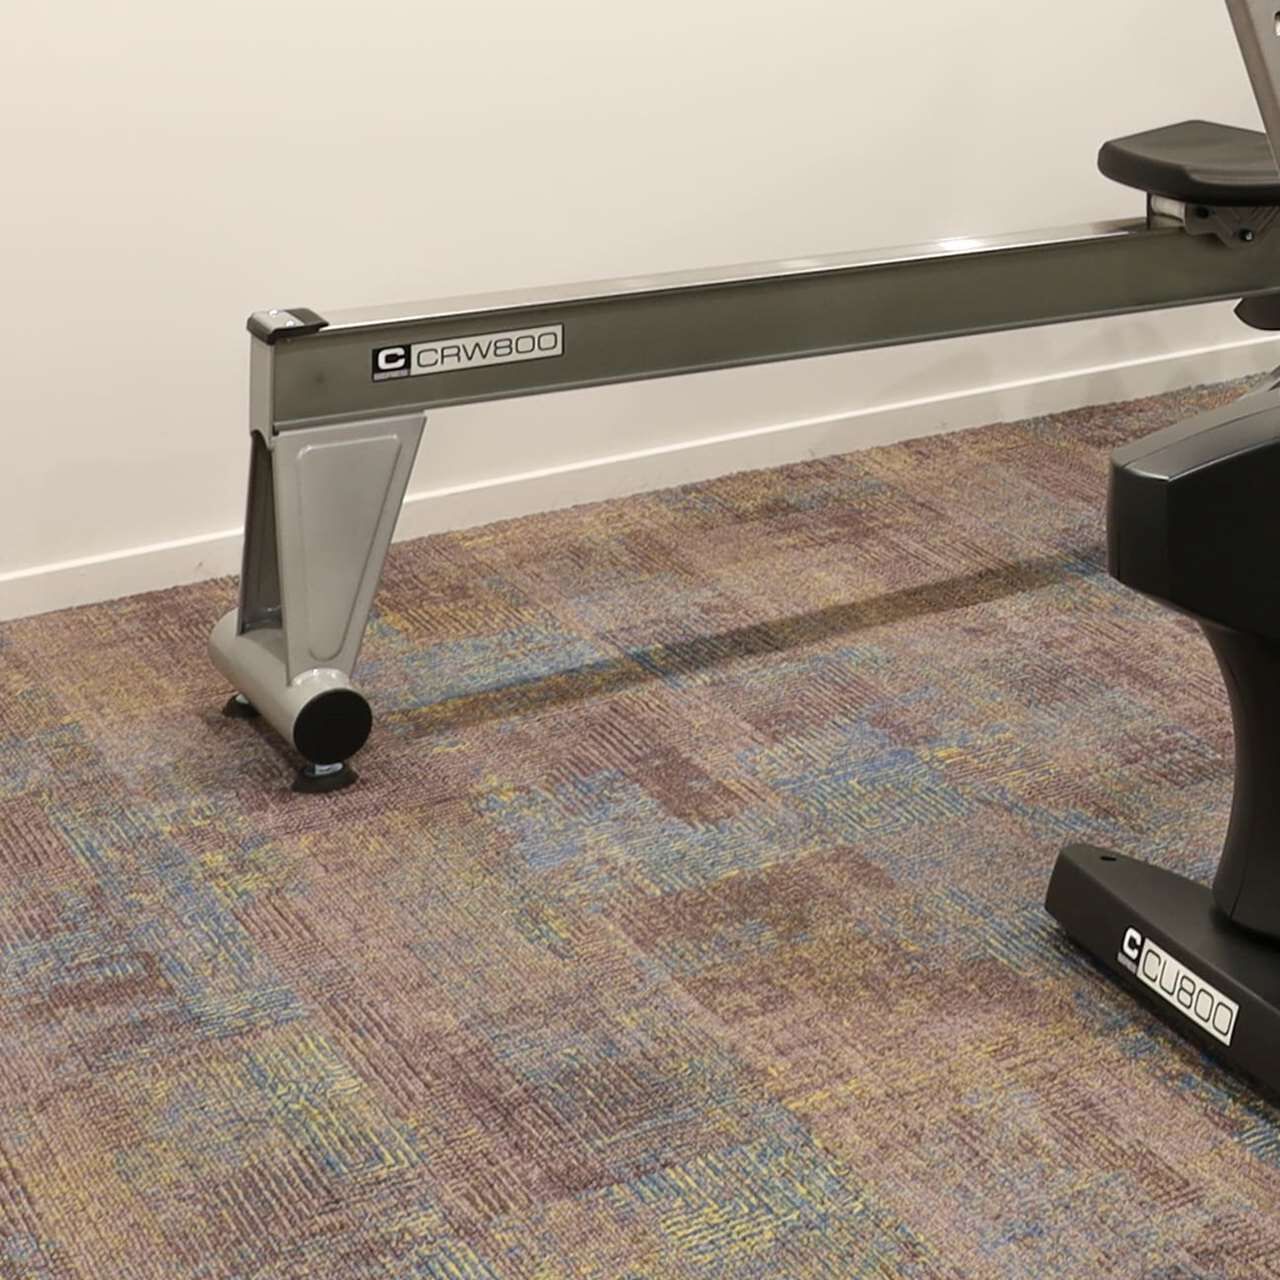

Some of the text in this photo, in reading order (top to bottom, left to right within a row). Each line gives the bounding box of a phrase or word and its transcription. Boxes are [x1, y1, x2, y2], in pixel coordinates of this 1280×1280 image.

[378, 331, 558, 370] C CRW800
[1122, 927, 1233, 1037] C CU800
